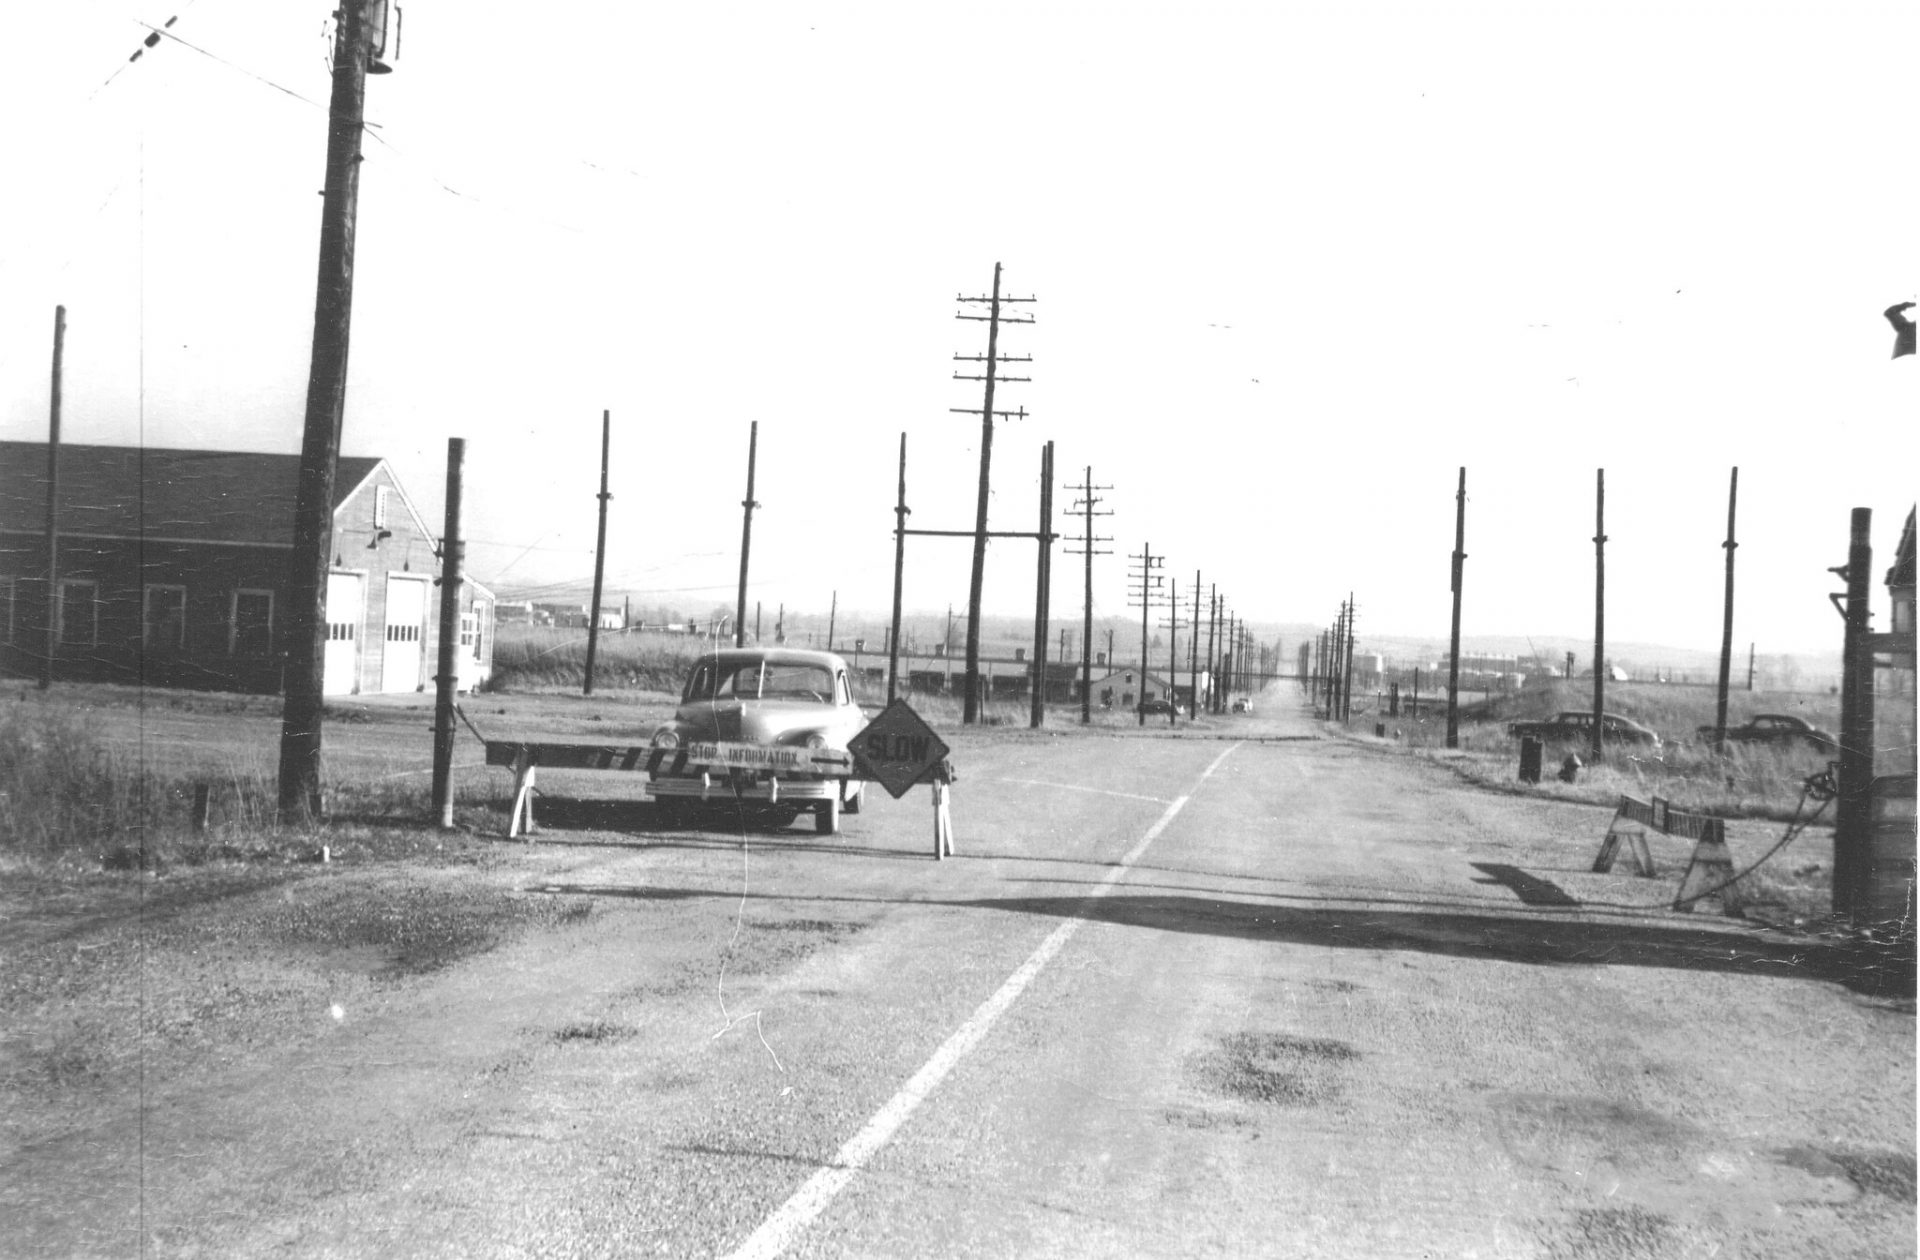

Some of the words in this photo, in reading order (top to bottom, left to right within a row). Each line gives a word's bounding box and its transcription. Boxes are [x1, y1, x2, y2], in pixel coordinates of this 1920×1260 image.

[691, 744, 718, 760] STOP
[729, 747, 798, 764] INFORMATION
[867, 733, 929, 762] SLOW
